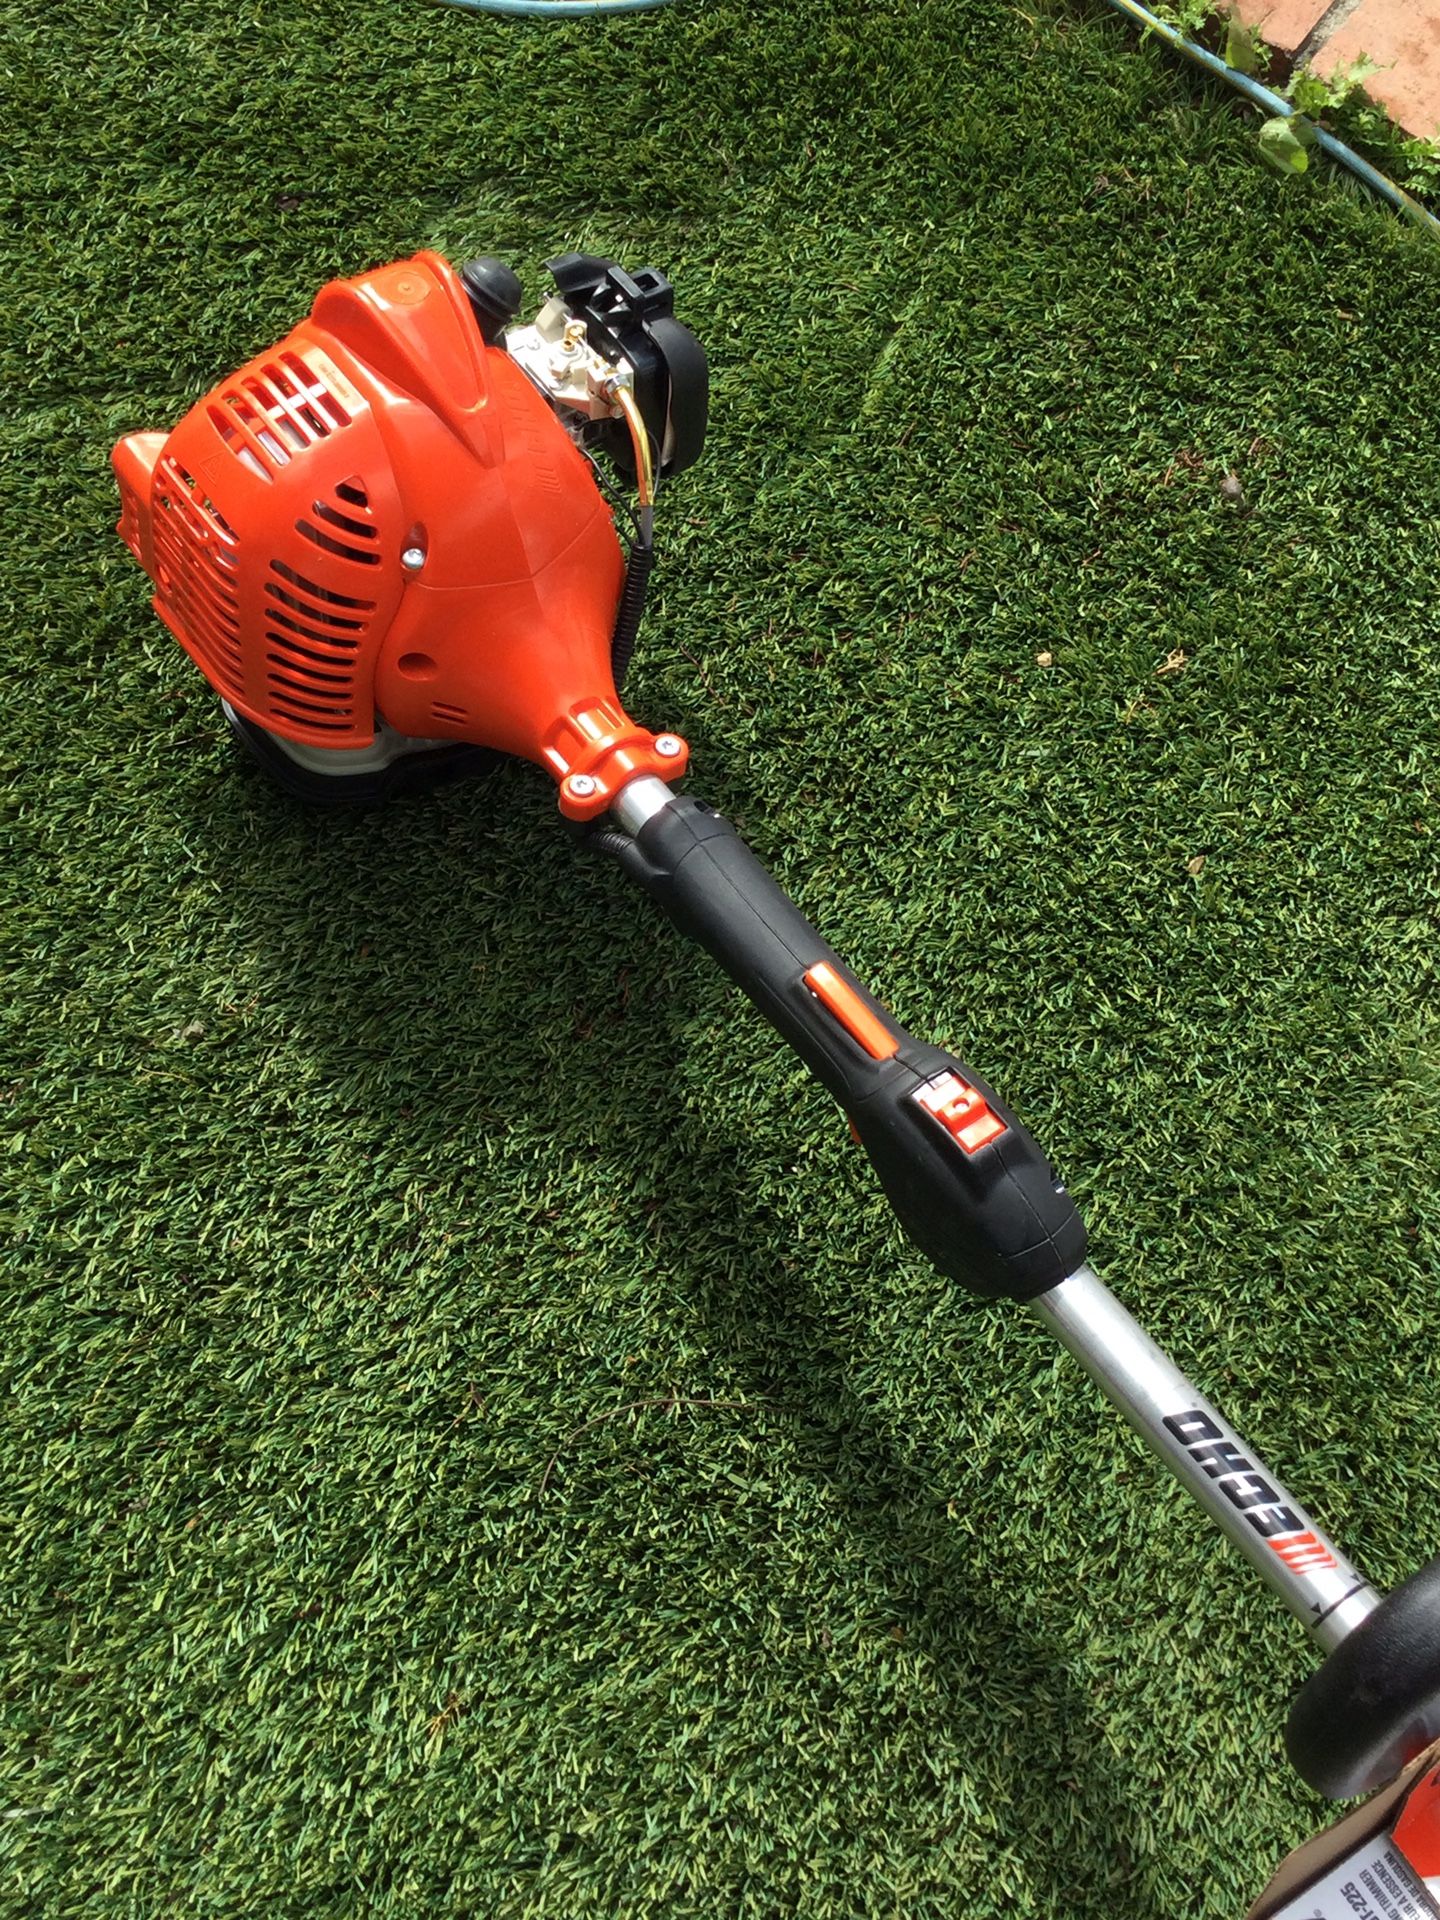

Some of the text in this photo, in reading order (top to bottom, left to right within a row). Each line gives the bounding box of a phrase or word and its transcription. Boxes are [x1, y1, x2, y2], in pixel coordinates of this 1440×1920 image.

[1162, 1409, 1304, 1537] ECHO
[1359, 1868, 1392, 1912] TRIMMER
[1371, 1859, 1403, 1899] ESSENCE
[1384, 1850, 1412, 1888] GASOLINA
